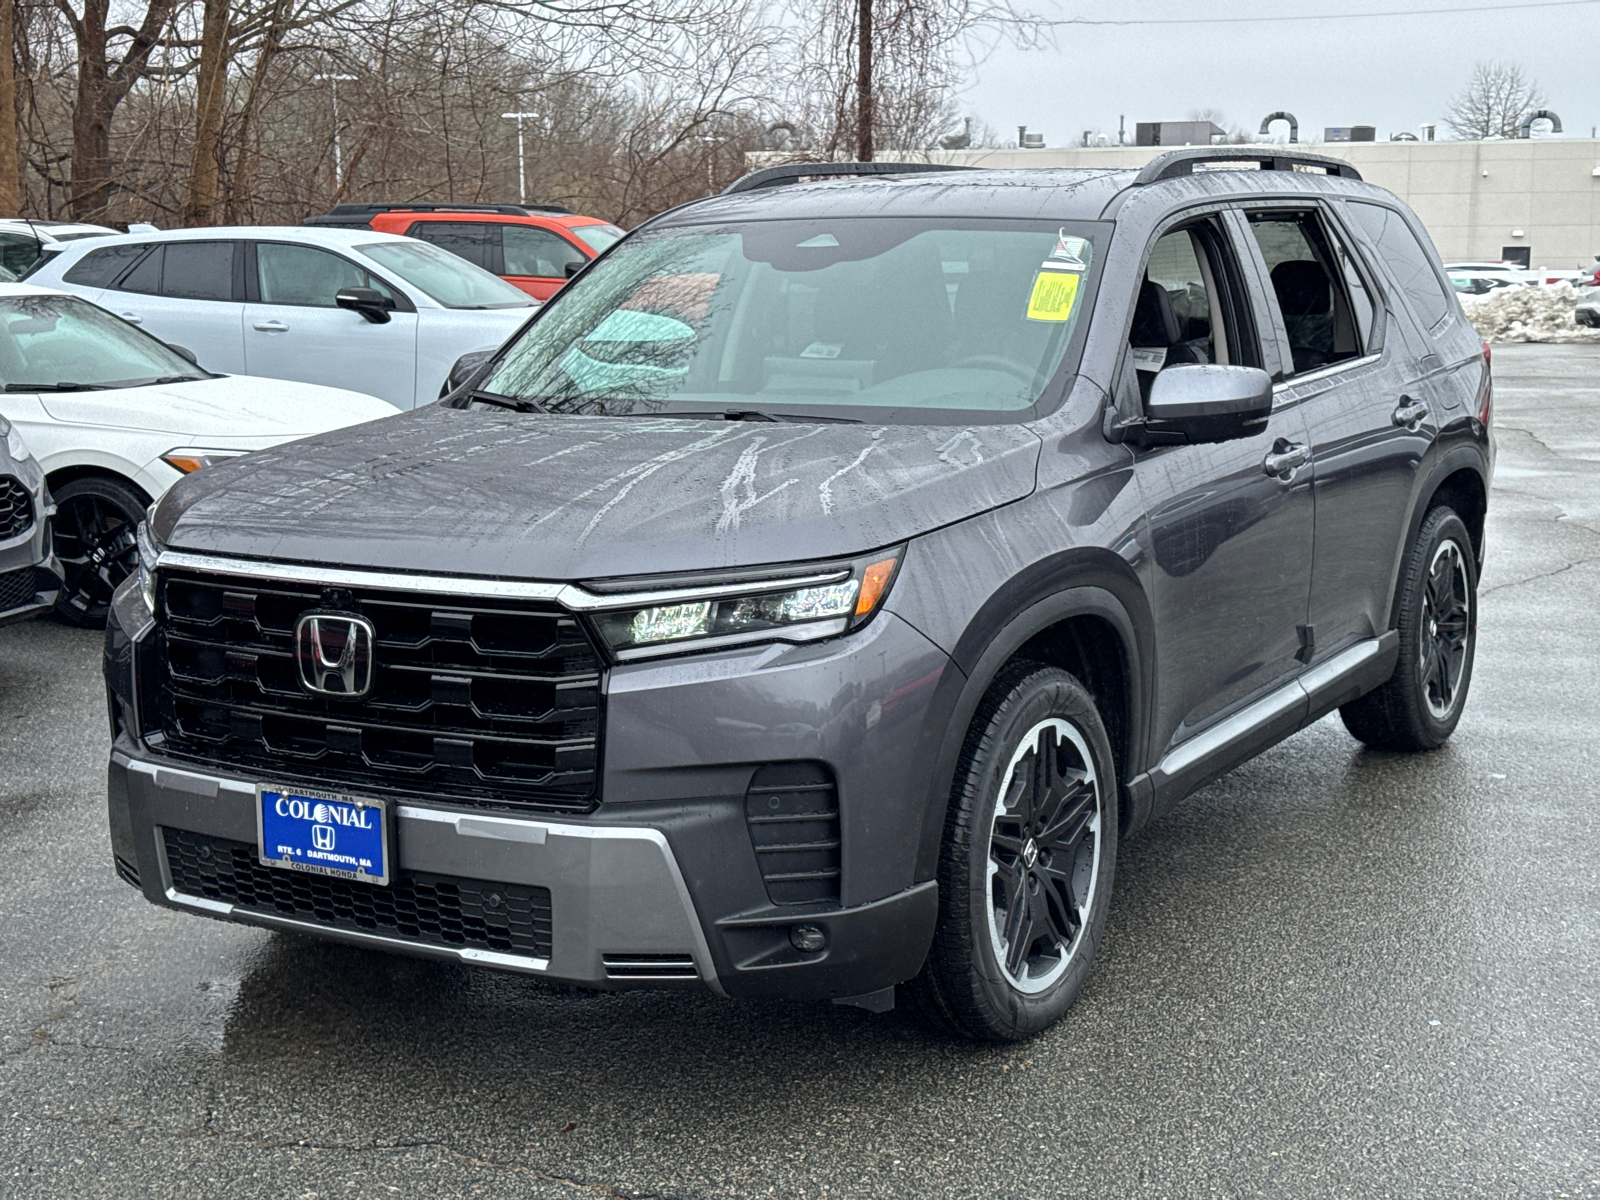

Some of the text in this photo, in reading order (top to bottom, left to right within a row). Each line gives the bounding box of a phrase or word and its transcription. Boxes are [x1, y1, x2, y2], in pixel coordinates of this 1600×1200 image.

[275, 798, 373, 829] COLONIAL
[277, 845, 372, 868] RTE. 6 DARTMOUTH, MA
[291, 863, 358, 879] COLONIAL HONDA
